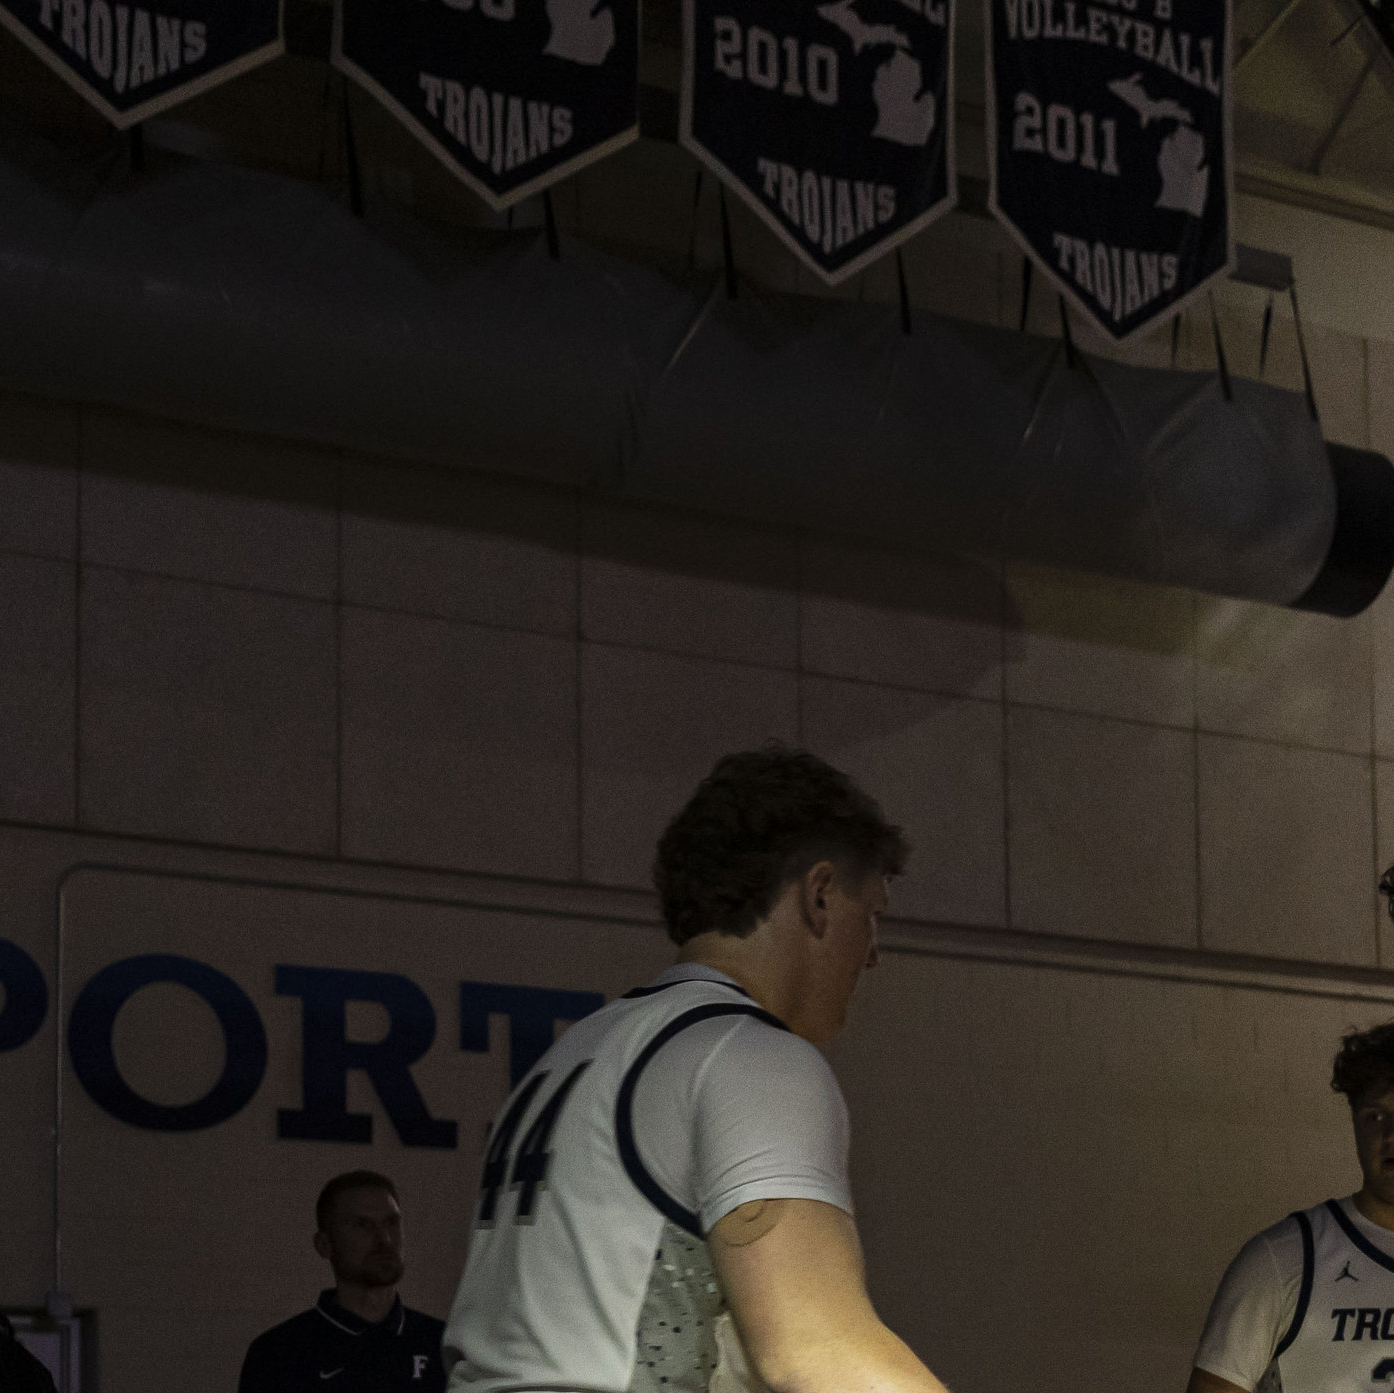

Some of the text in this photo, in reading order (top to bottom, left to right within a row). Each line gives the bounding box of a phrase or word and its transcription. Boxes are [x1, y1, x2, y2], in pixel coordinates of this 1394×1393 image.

[713, 16, 840, 107] 2010
[418, 72, 574, 175] TROJANS
[1012, 92, 1120, 176] 2011
[757, 158, 896, 256] TROJANS
[1053, 231, 1178, 322] TROJANS
[412, 1355, 429, 1378] F
